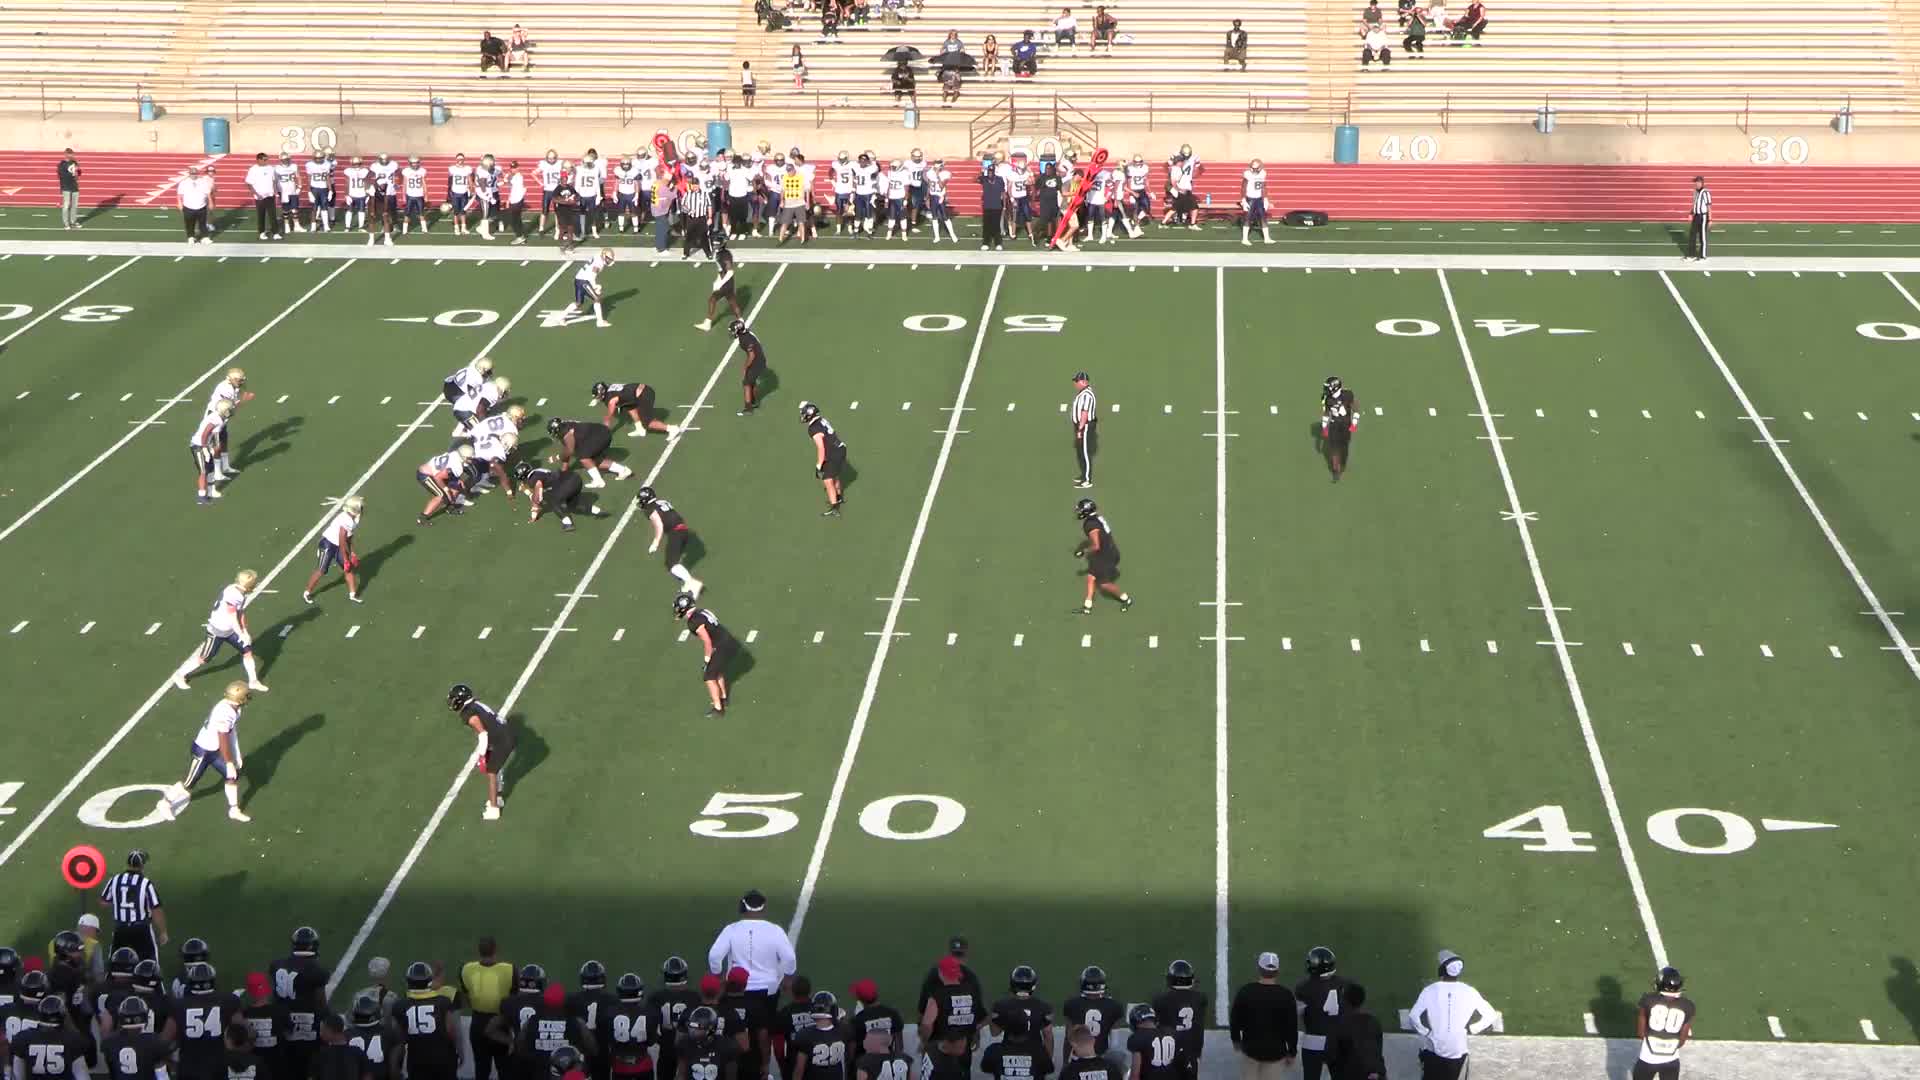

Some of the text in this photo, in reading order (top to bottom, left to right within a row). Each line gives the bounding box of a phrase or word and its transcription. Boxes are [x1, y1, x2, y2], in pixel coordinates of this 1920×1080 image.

[280, 126, 337, 153] 30
[1008, 136, 1062, 164] 50
[1379, 135, 1438, 162] 40
[1750, 135, 1809, 164] 30
[580, 176, 595, 188] 15
[841, 172, 850, 184] 5
[120, 886, 135, 909] L
[1322, 989, 1340, 1016] 4
[185, 1006, 223, 1038] 54
[405, 1004, 437, 1035] 15
[613, 1014, 648, 1043] 84
[1084, 1008, 1103, 1037] 6
[1175, 1007, 1194, 1032] 3
[1649, 1003, 1686, 1034] 80
[28, 1045, 65, 1075] 75
[119, 1047, 138, 1074] 9
[1151, 1036, 1176, 1067] 10
